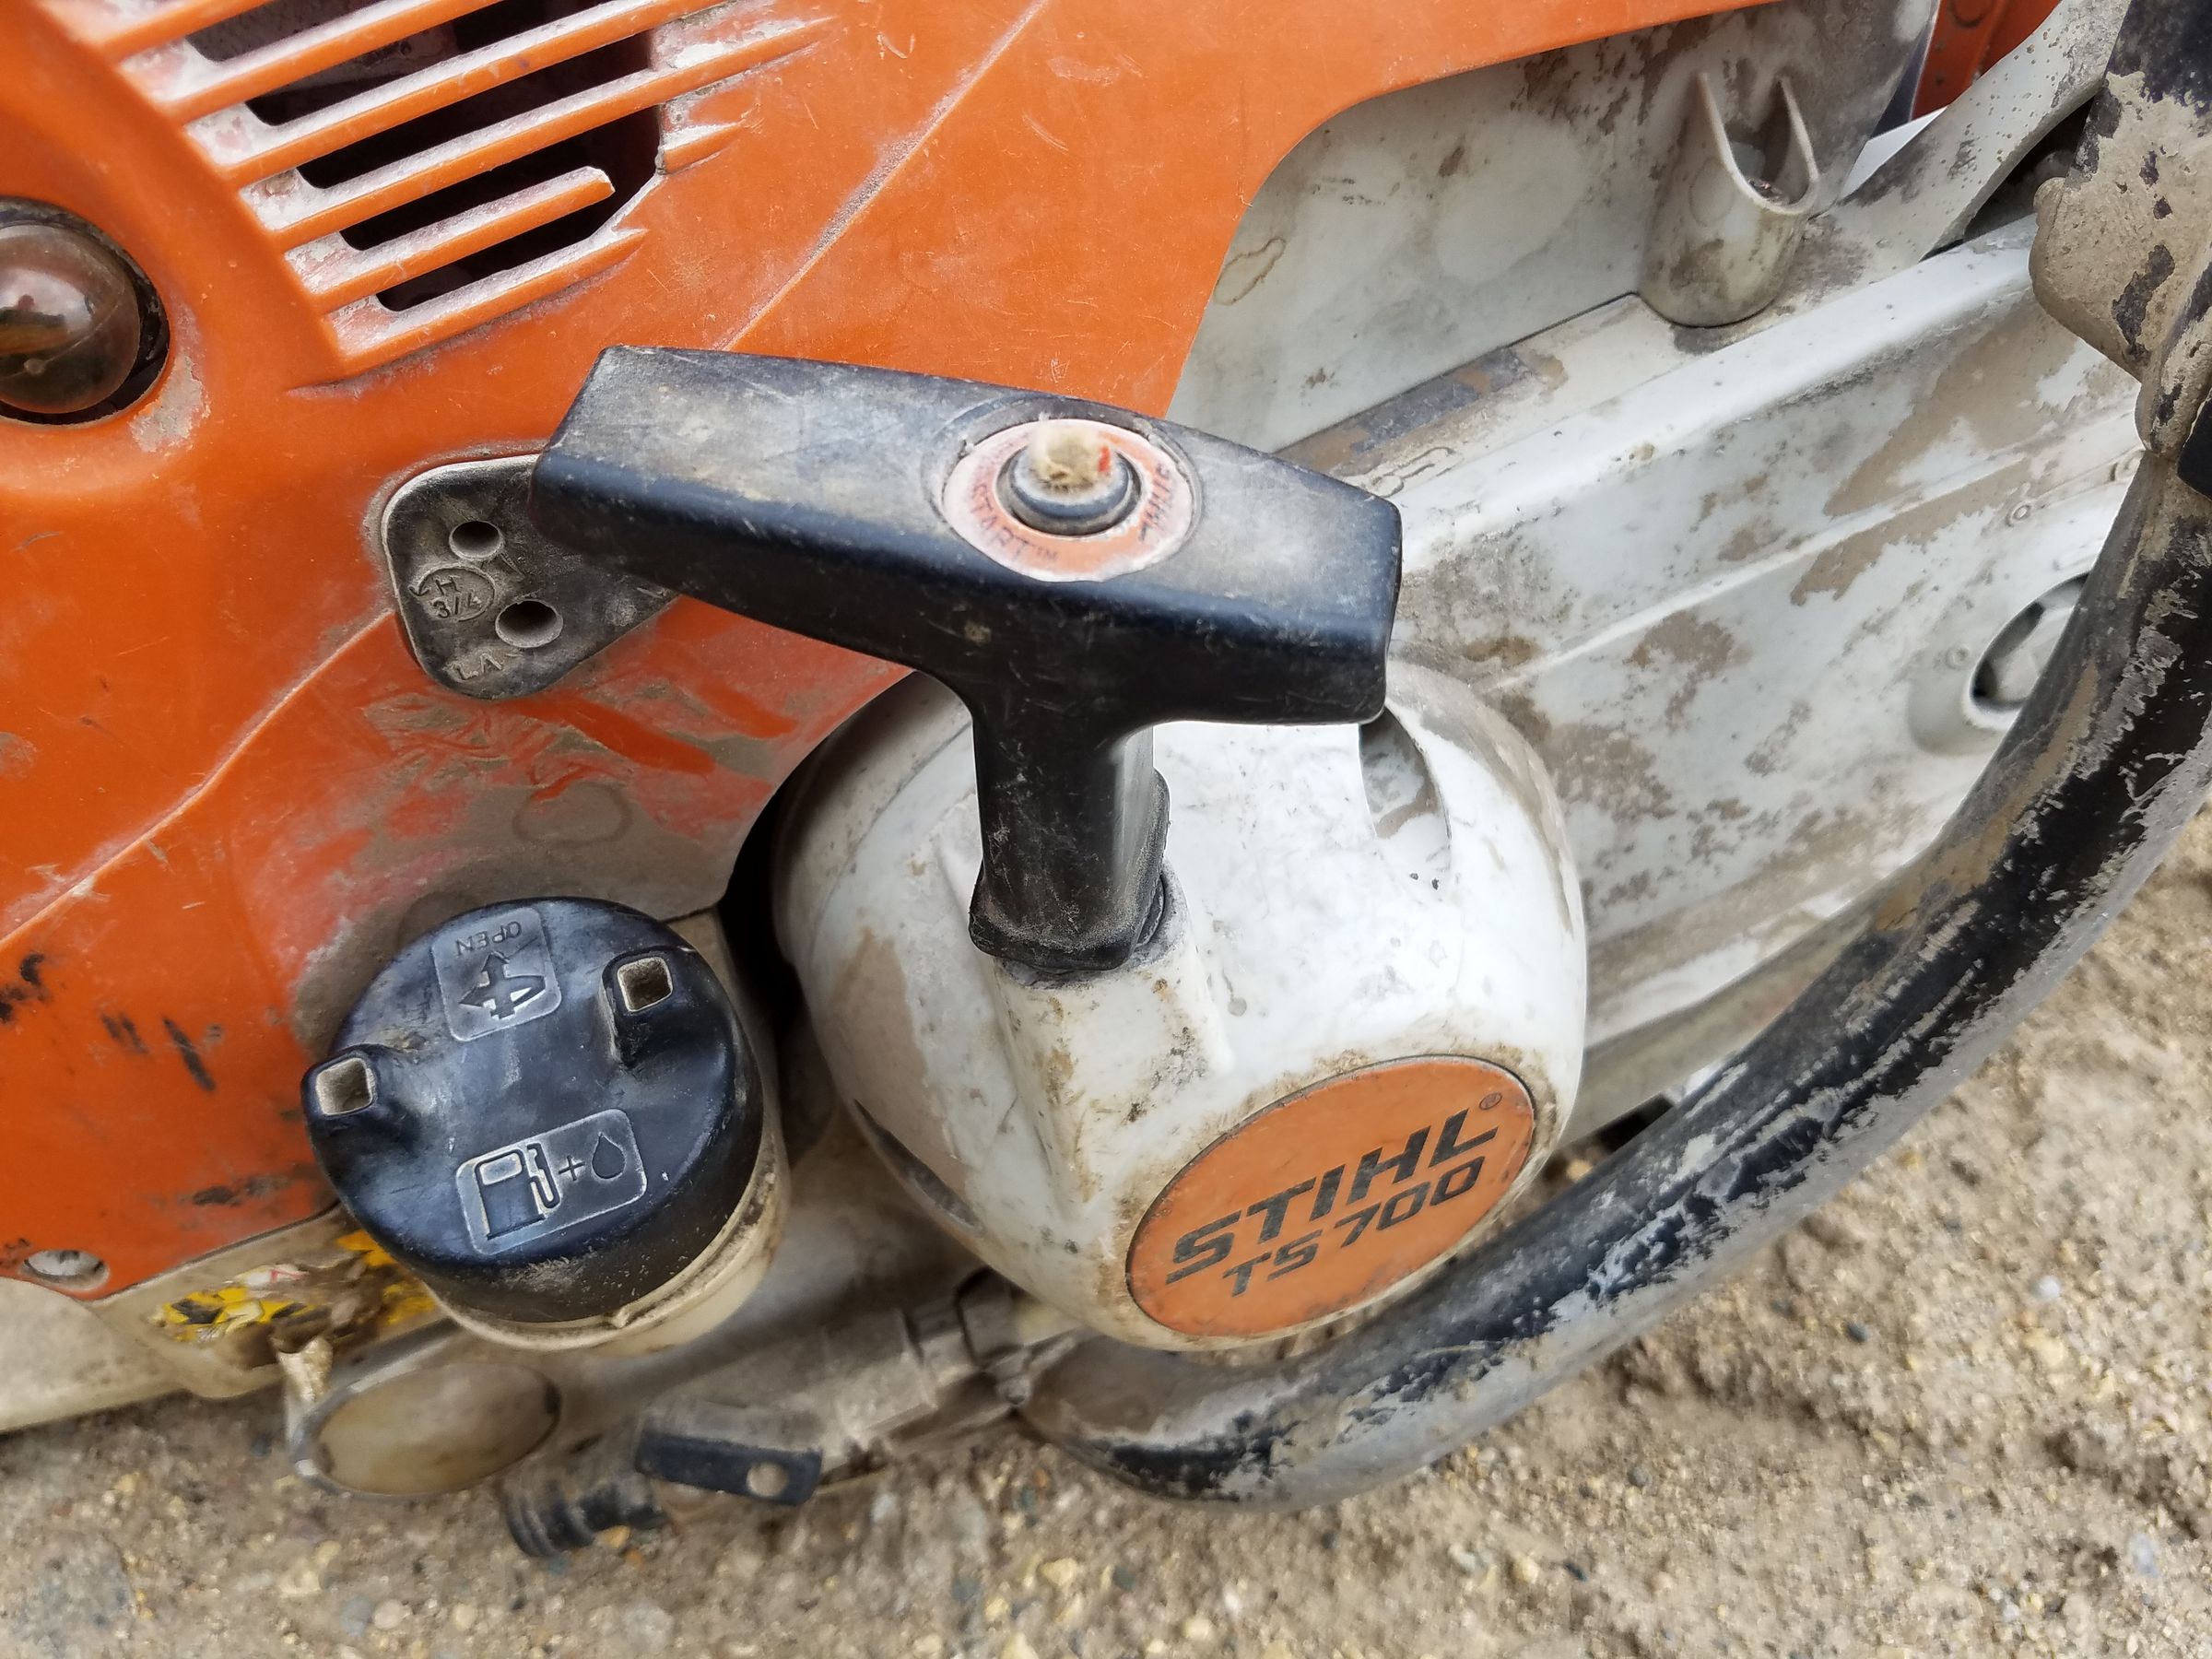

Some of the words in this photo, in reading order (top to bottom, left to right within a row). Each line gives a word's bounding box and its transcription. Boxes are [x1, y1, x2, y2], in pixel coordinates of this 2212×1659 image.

[454, 921, 523, 957] OPEN
[1166, 1108, 1499, 1285] STIHL
[1222, 1229, 1324, 1297] TS
[1335, 1155, 1486, 1249] 700
